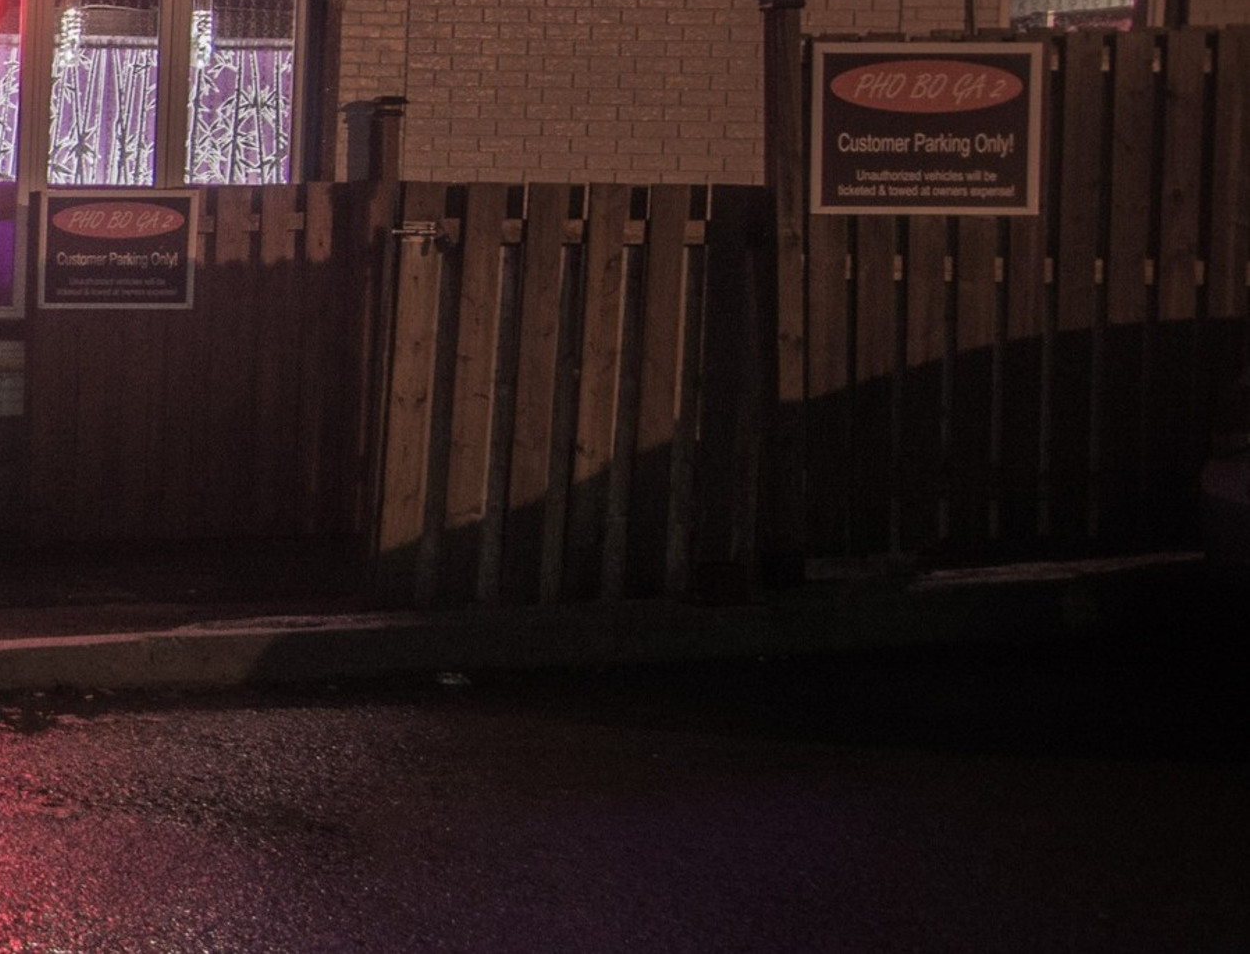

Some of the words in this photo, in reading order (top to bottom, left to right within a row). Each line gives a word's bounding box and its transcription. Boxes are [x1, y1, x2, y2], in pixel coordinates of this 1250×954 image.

[853, 72, 906, 99] PHO
[911, 73, 948, 98] BO
[953, 73, 986, 105] GA
[990, 80, 1007, 98] 2
[838, 132, 911, 153] Customer
[914, 132, 971, 158] Parking
[975, 132, 1015, 158] Only!
[856, 169, 922, 182] Unauthorized
[924, 170, 964, 182] vehicles
[966, 170, 982, 182] will
[984, 170, 998, 182] be
[878, 185, 886, 196] &
[889, 185, 919, 196] towed
[921, 186, 930, 196] at
[68, 210, 105, 229] PHO
[107, 210, 133, 229] BO
[136, 211, 160, 232] GA
[162, 214, 173, 228] 2
[56, 251, 106, 266] Customer
[109, 251, 147, 268] Parking
[150, 251, 178, 268] Only!
